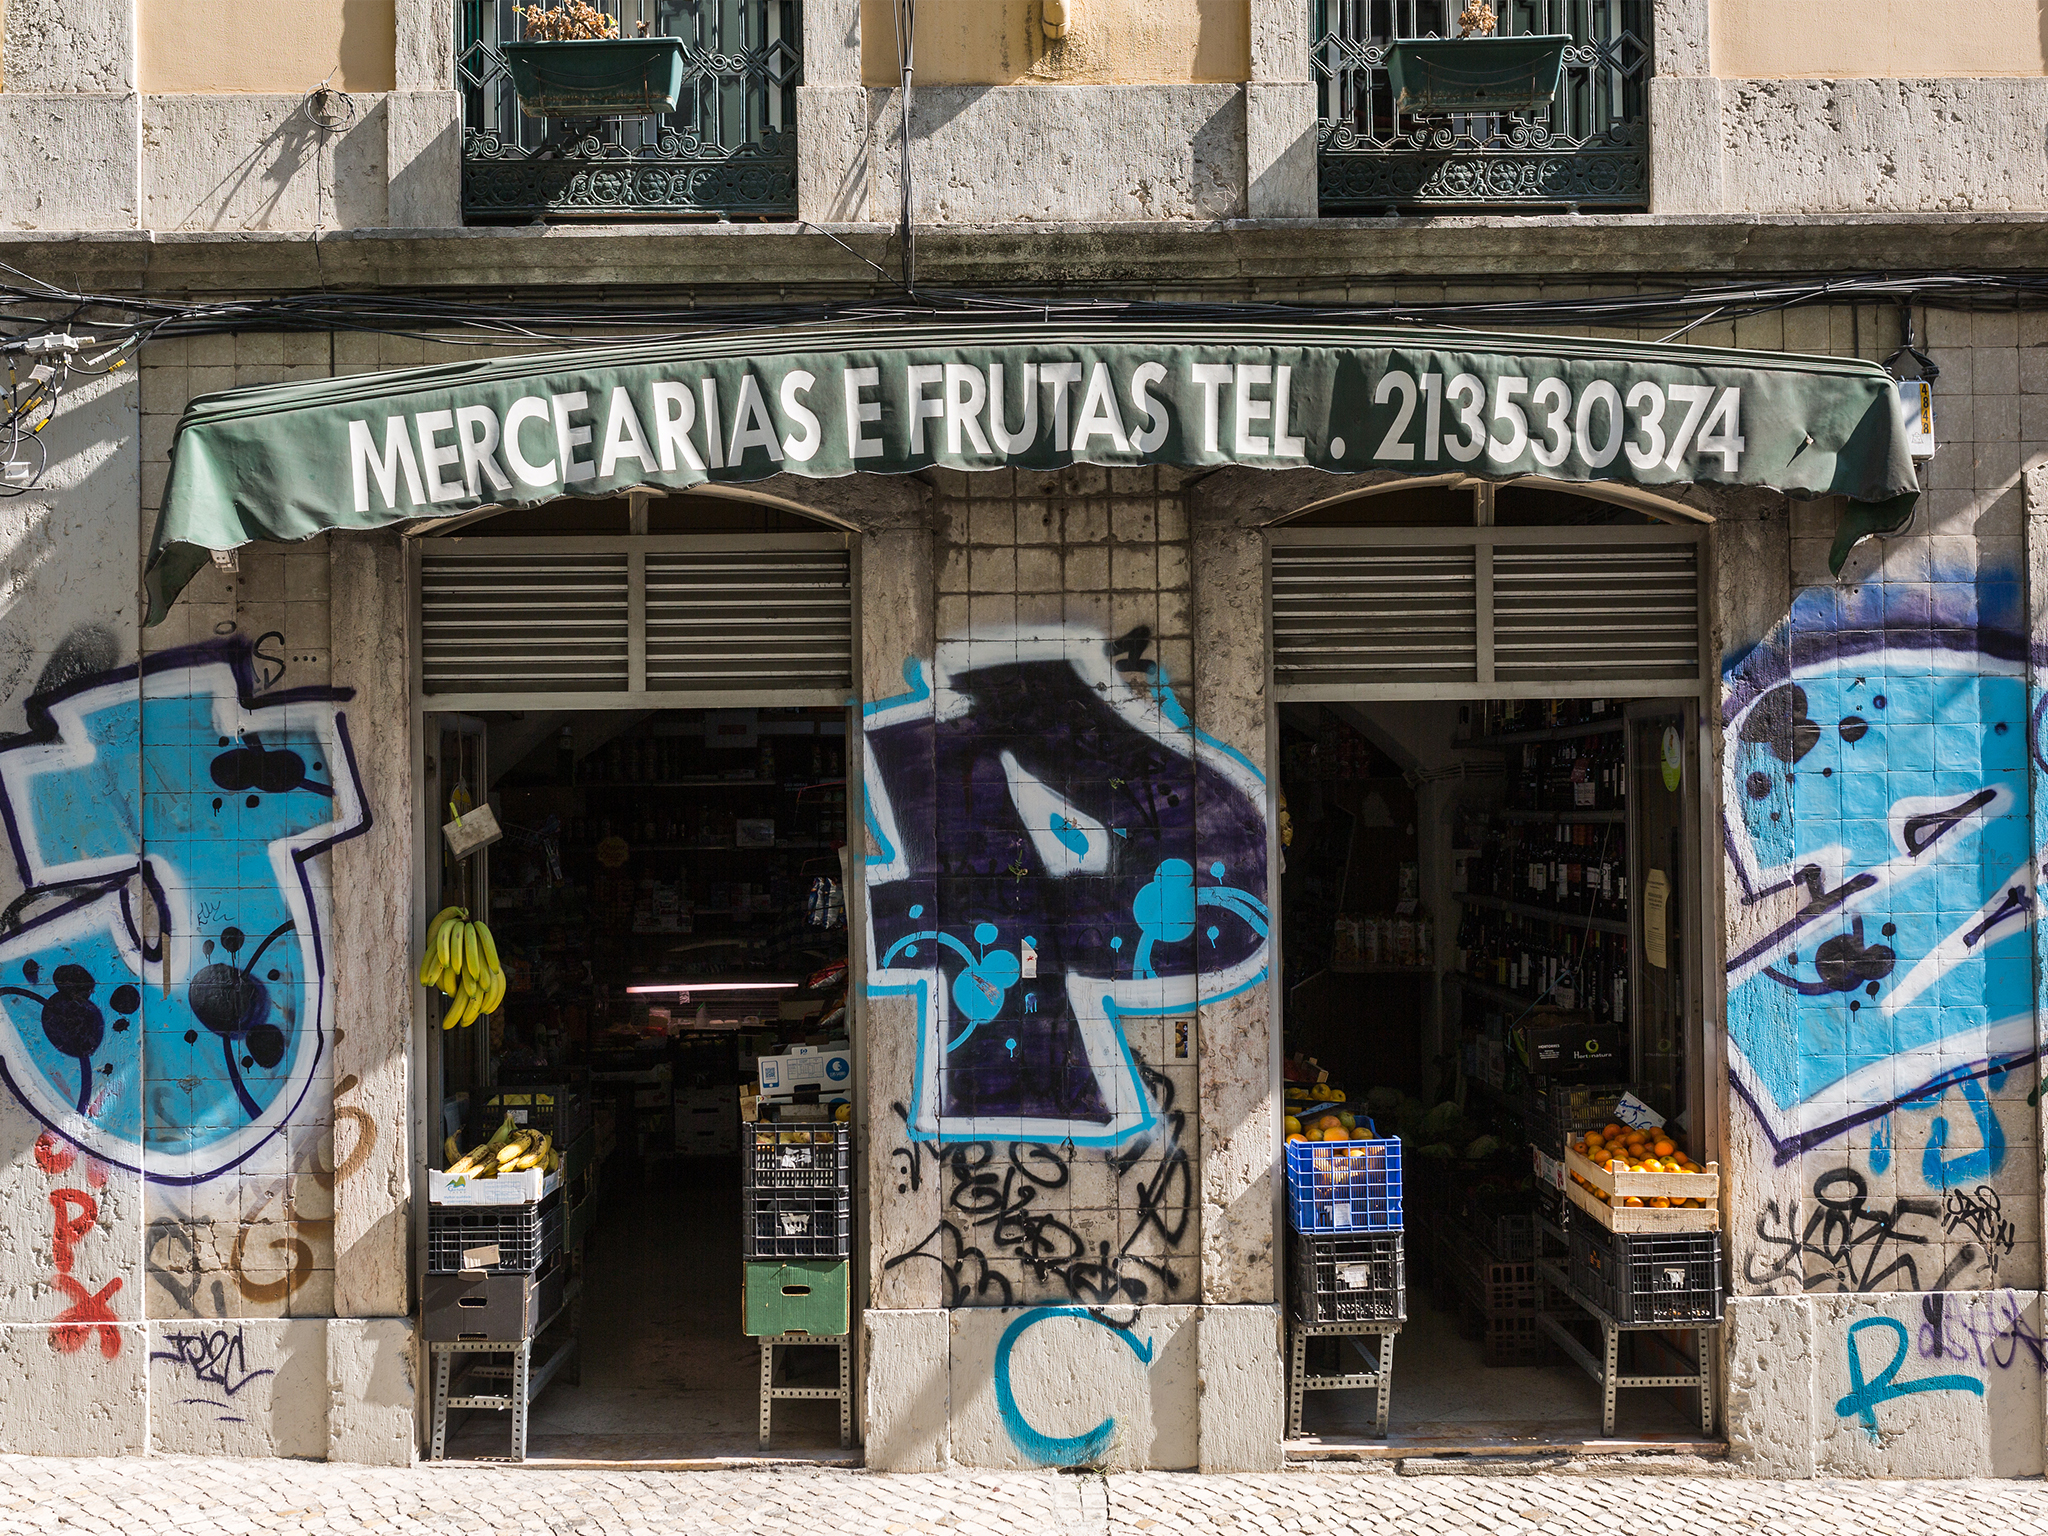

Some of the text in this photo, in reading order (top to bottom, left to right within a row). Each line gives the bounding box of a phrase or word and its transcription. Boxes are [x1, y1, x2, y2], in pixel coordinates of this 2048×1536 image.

[348, 369, 822, 513] MERCEARIAS
[843, 366, 885, 459] E
[906, 361, 1171, 455] FRUTAS
[1191, 363, 1306, 458] TEL
[1372, 369, 1746, 473] 213530374
[1920, 383, 1930, 434] 4848
